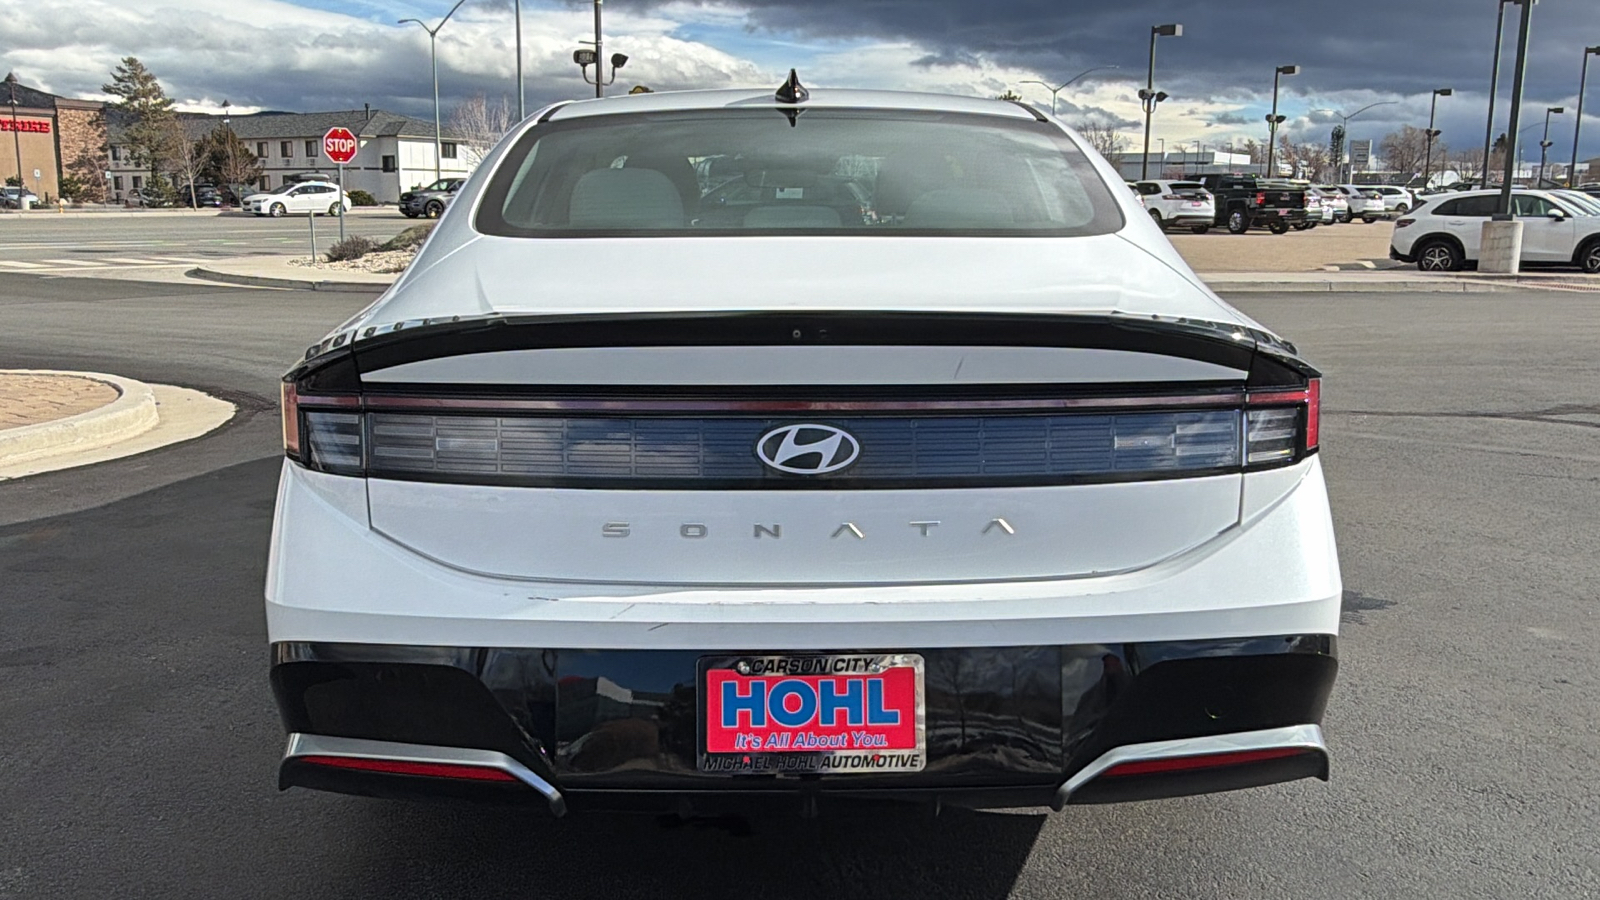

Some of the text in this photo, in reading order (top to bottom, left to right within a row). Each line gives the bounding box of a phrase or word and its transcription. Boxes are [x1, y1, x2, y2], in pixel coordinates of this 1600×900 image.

[326, 138, 354, 153] STOP
[601, 519, 1015, 540] SONATA
[751, 657, 874, 674] CARSON CITY
[721, 678, 901, 728] HOHL
[735, 730, 888, 749] It's All About You.
[703, 754, 920, 771] MICHAEL HOHL AUTOMOTIVE
